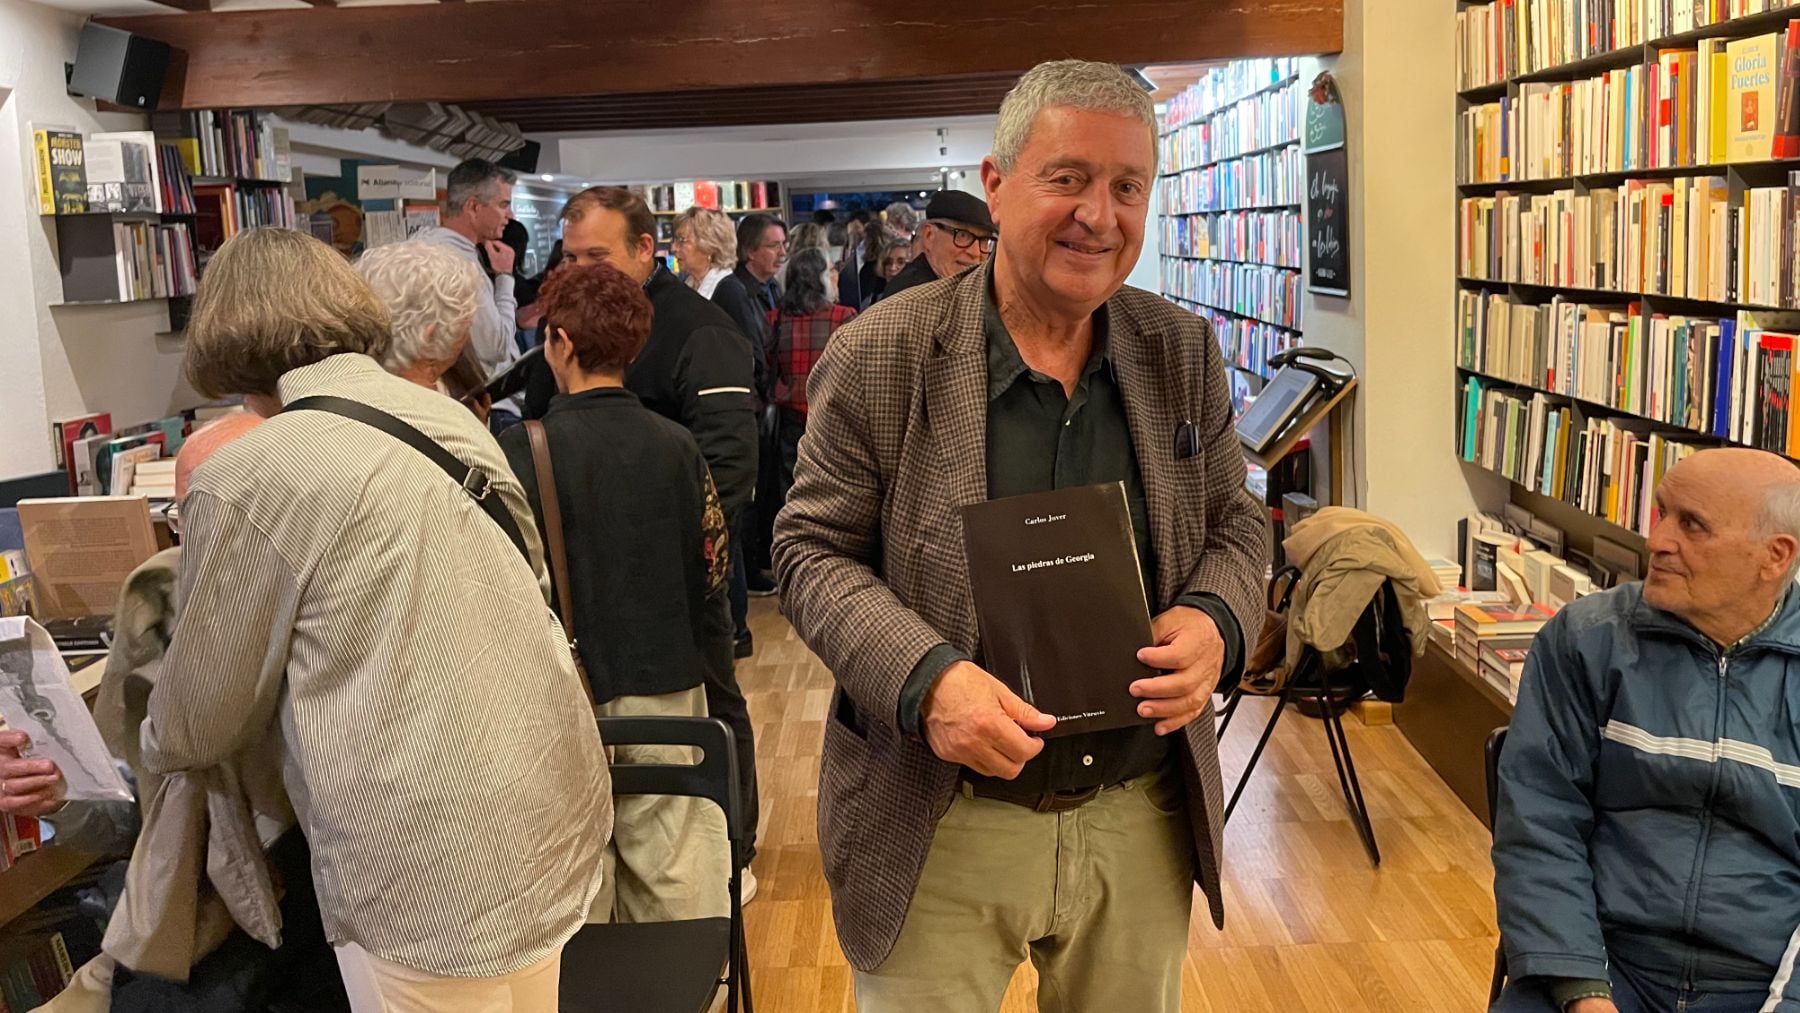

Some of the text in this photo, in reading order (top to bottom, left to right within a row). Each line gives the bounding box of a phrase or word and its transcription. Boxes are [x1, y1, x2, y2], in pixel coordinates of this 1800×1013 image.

[1734, 53, 1767, 73] Gloria
[1731, 71, 1771, 91] Fuertes
[51, 148, 83, 166] SHOW
[1024, 513, 1067, 525] Carlos Jover
[1012, 552, 1095, 573] Las piedras de Georgia
[1057, 714, 1082, 722] Ediciones
